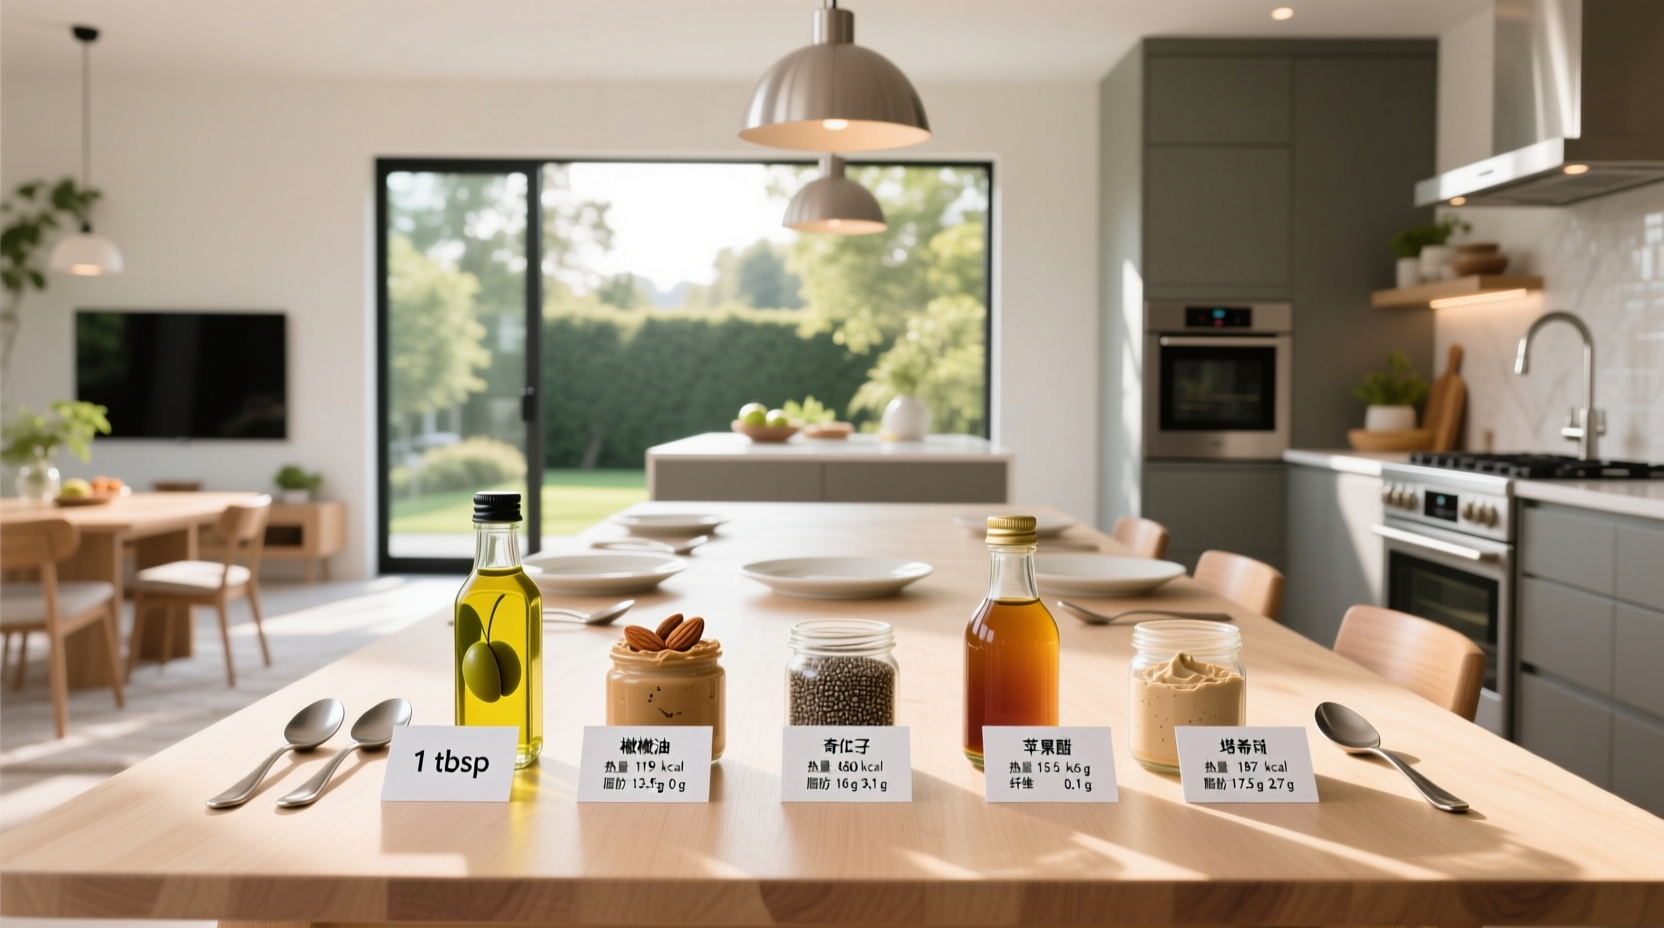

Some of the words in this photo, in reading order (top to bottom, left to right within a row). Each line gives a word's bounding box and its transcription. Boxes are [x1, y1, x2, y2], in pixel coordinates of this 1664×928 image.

[415, 749, 425, 772] 1
[435, 749, 490, 779] tbsp
[636, 760, 656, 773] 119
[661, 760, 684, 773] kcal
[860, 760, 883, 773] kcal
[1264, 760, 1288, 773] kcal
